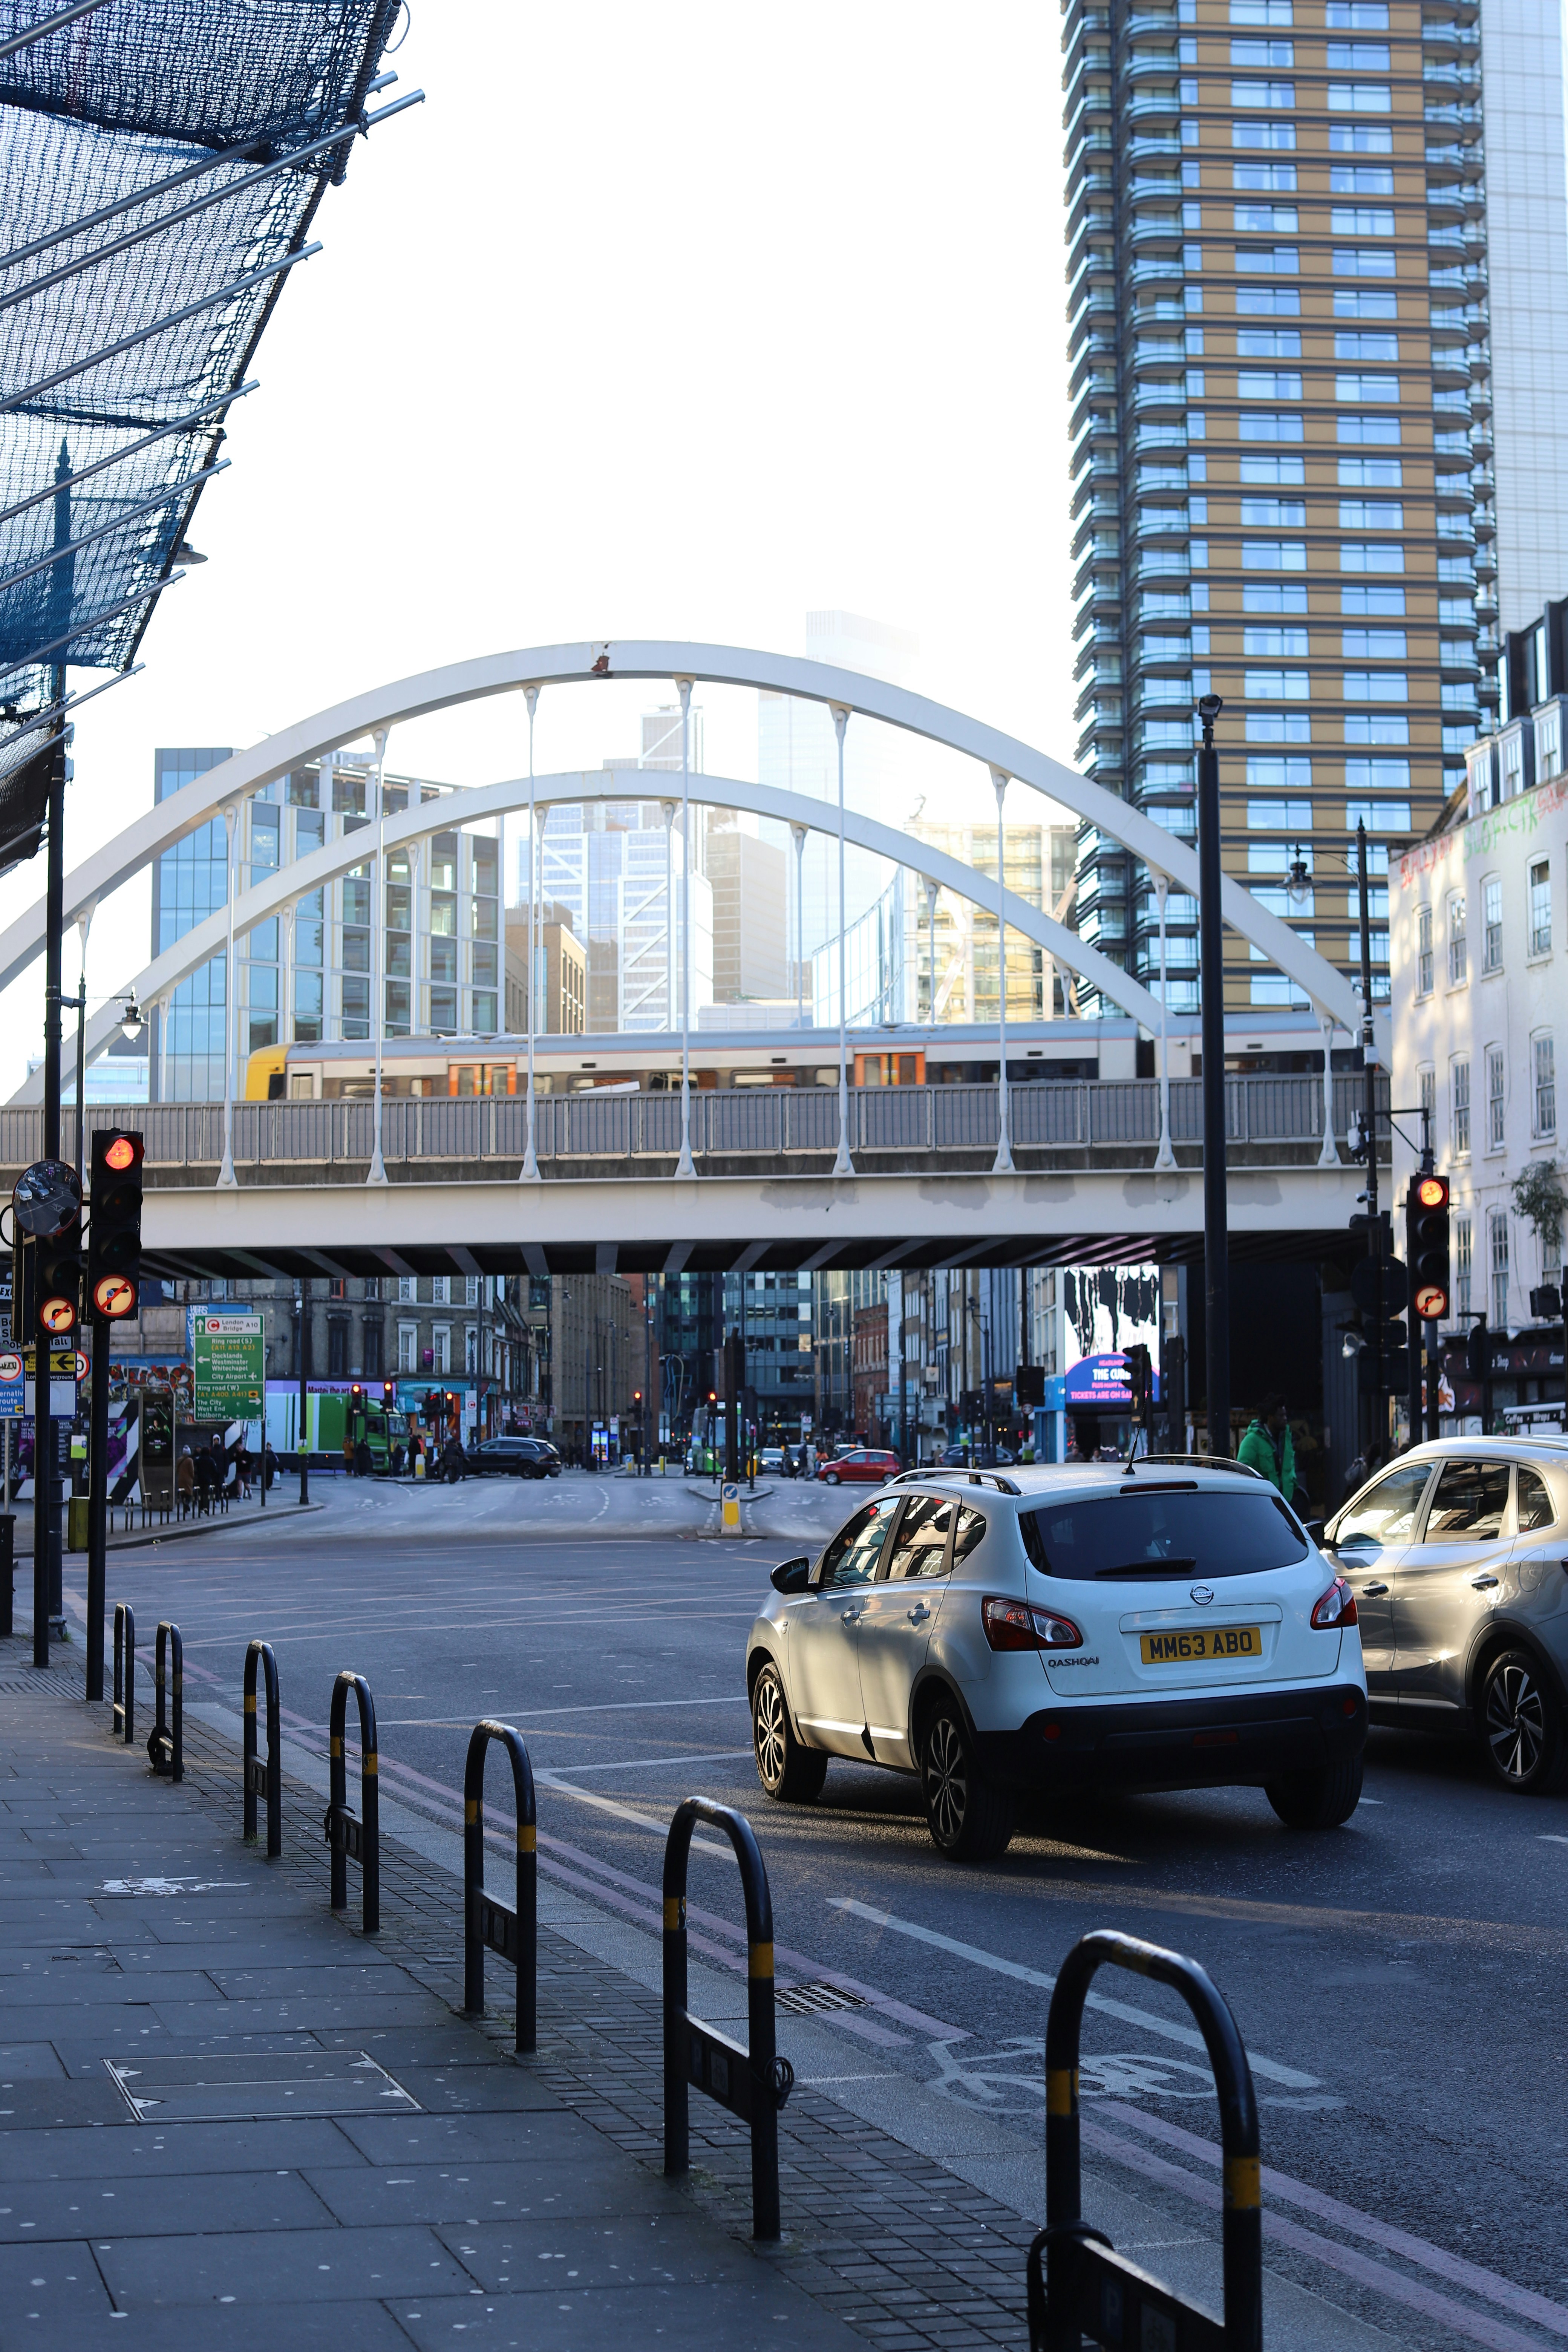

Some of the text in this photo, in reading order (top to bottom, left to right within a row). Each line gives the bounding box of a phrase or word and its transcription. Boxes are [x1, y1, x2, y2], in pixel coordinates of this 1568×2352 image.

[77, 1360, 84, 1371] 0
[1092, 1368, 1109, 1380] THE
[1070, 1391, 1096, 1399] TICKETS
[1505, 1413, 1523, 1424] Coffee
[1150, 1635, 1205, 1659] MM63
[1048, 1656, 1099, 1668] QASHQAI
